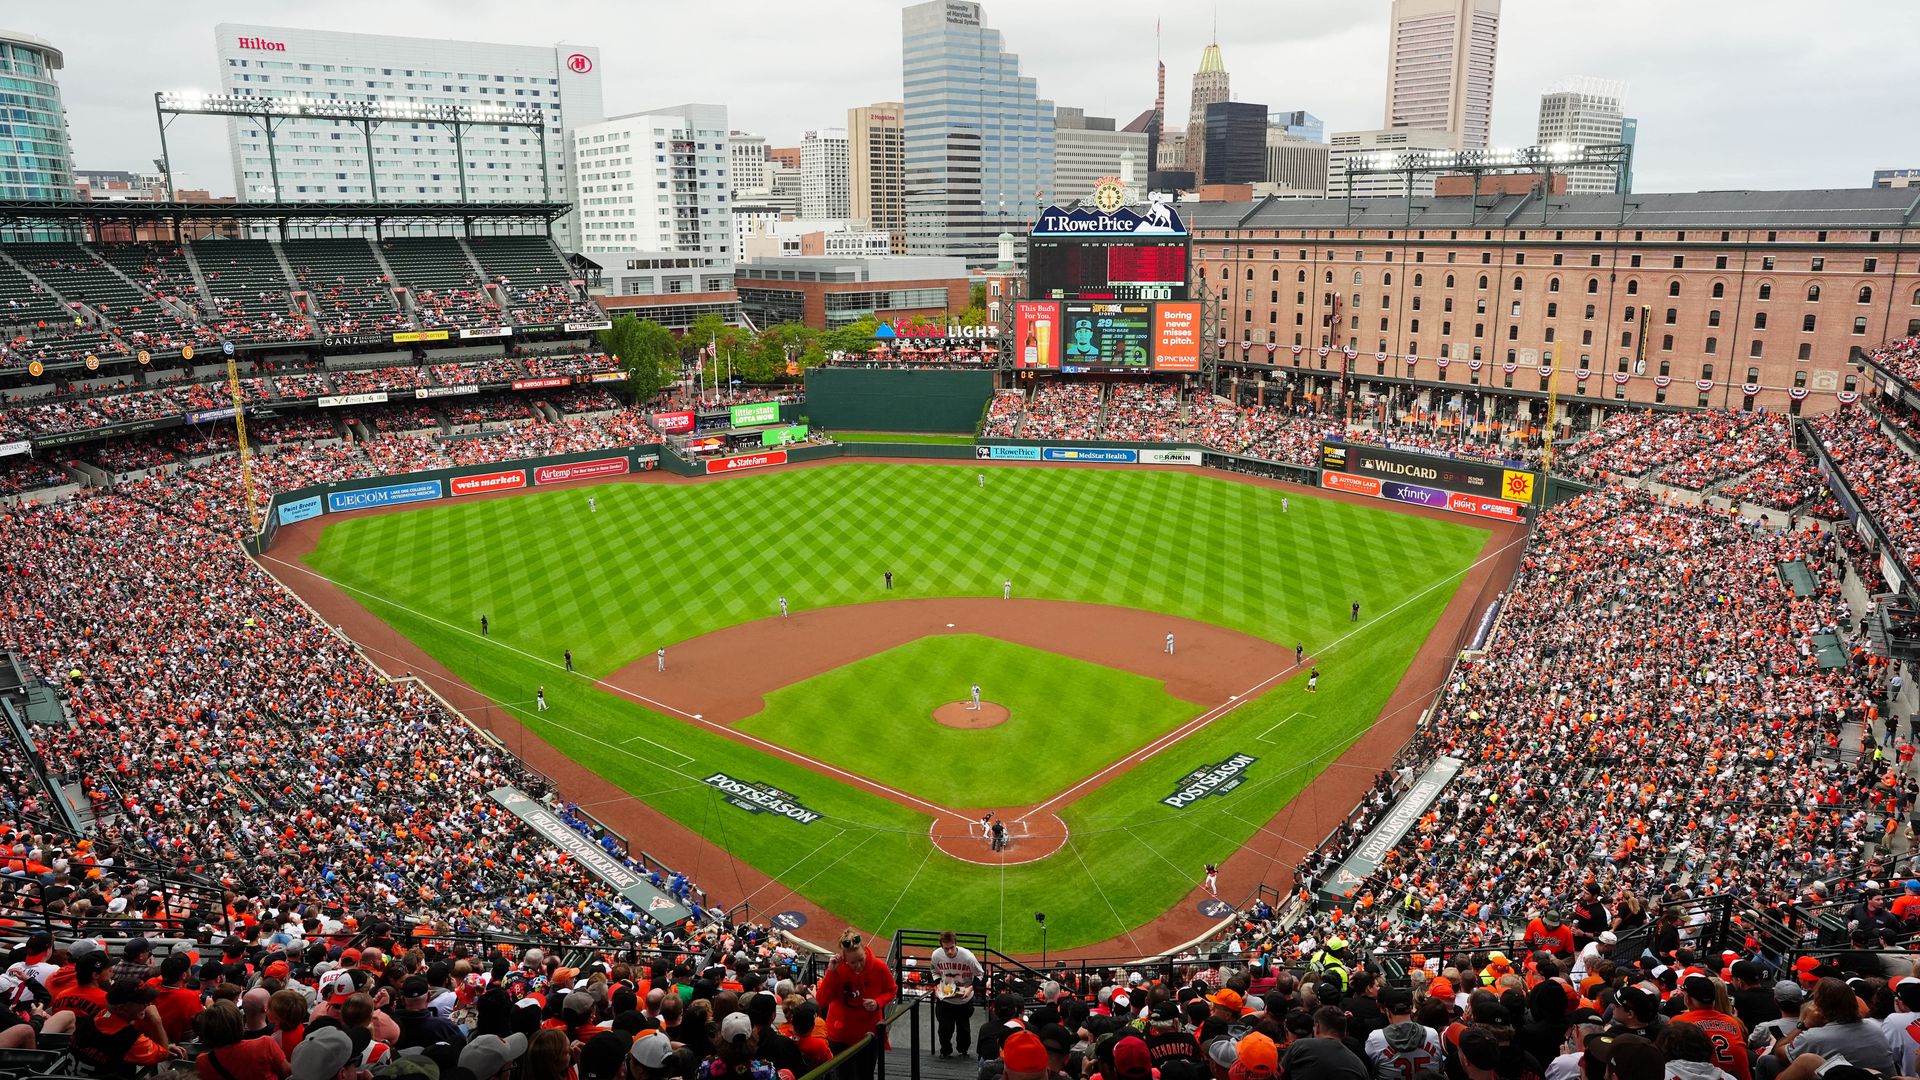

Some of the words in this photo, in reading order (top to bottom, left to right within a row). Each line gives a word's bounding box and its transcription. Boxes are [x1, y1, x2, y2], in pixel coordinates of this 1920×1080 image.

[947, 4, 968, 12] University
[238, 37, 286, 51] Hilton
[575, 57, 585, 69] H
[1164, 312, 1192, 320] Boring
[895, 319, 944, 337] Coors
[948, 326, 999, 337] LIGHT
[1097, 319, 1113, 327] 29
[325, 337, 358, 346] GANZ
[1170, 337, 1194, 346] pitch.
[88, 359, 97, 367] 22
[140, 353, 149, 361] 33
[454, 385, 478, 394] UNION
[1343, 437, 1368, 447] Personal
[1369, 440, 1386, 448] Loans
[1390, 445, 1420, 453] MARINER
[1420, 448, 1450, 458] FINANCE
[736, 457, 752, 467] State
[752, 456, 767, 465] Farm
[1455, 453, 1483, 462] Personal
[1484, 457, 1504, 466] Loans
[541, 468, 570, 480] Airtemp
[457, 481, 480, 489] weis
[481, 475, 521, 486] markets
[1339, 477, 1361, 485] AUTUMN
[1363, 480, 1377, 488] LAKE
[336, 492, 388, 506] LECOM
[1397, 486, 1431, 503] xfinity
[299, 501, 317, 509] Breeze
[1453, 500, 1476, 511] HIGH'S
[1164, 754, 1255, 808] POSTSEASON
[705, 774, 818, 823] POSTSEASON
[530, 812, 573, 843] WELCOME
[604, 864, 634, 887] PARK
[1150, 1042, 1194, 1060] HENDRICKS
[1711, 1034, 1734, 1063] 2
